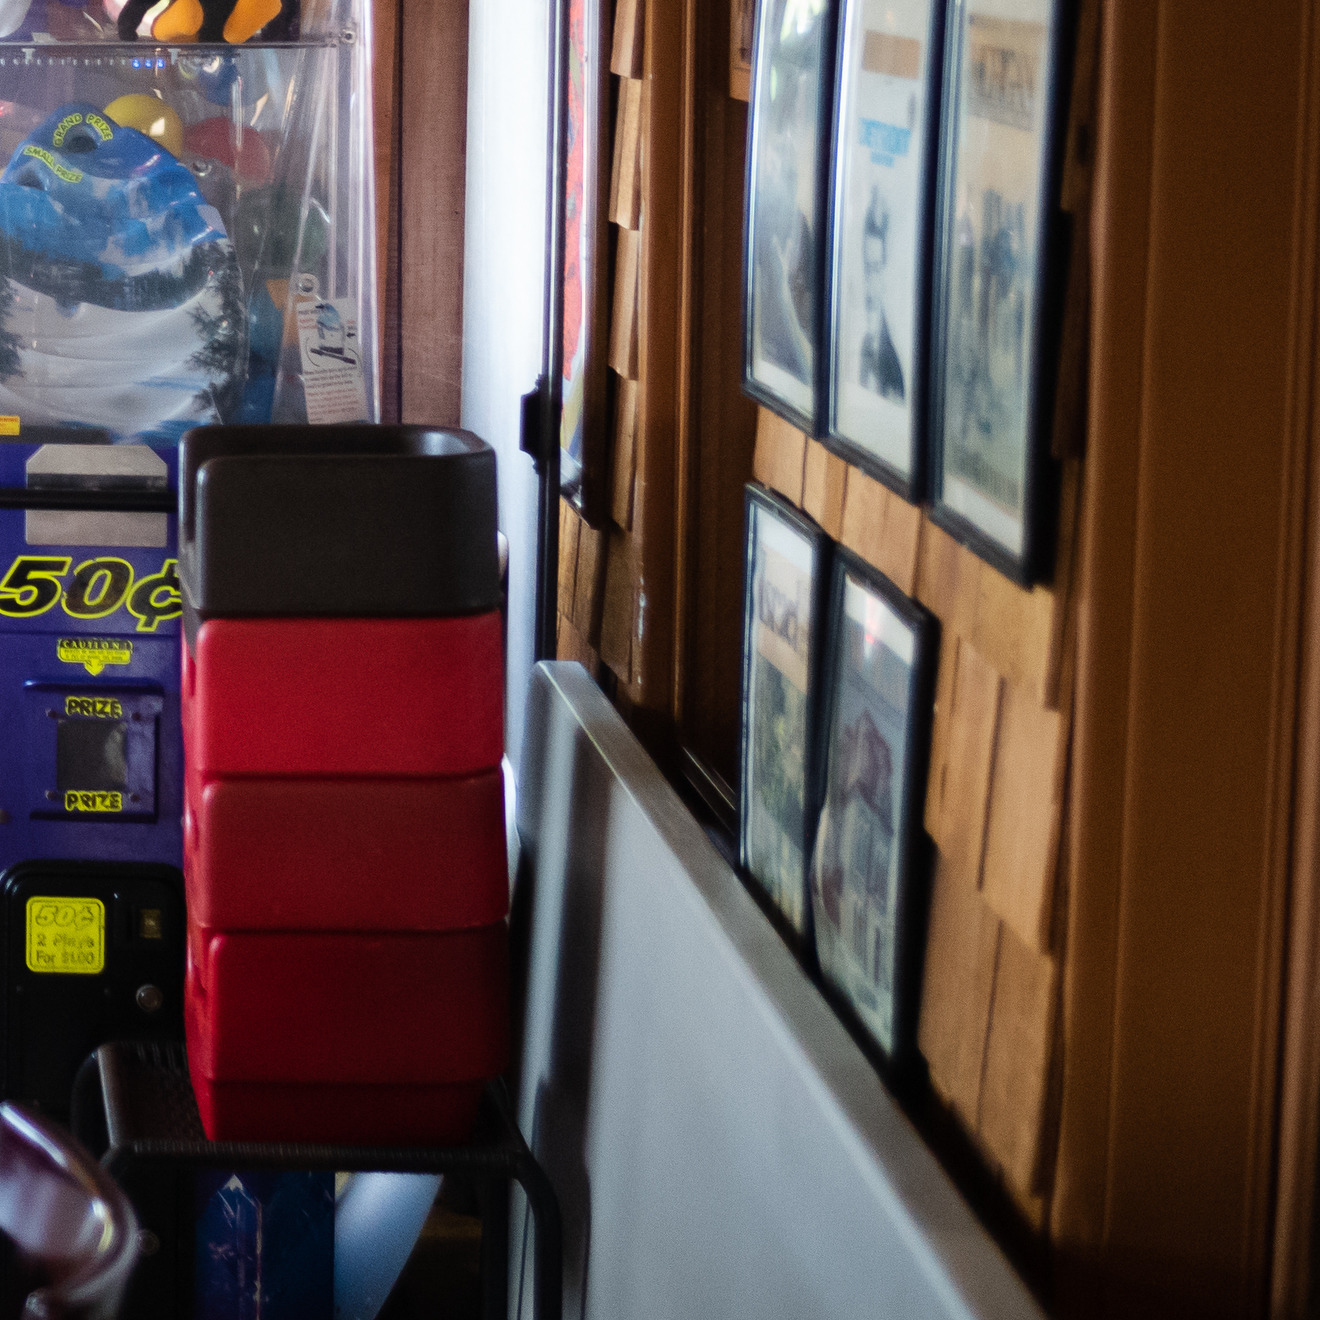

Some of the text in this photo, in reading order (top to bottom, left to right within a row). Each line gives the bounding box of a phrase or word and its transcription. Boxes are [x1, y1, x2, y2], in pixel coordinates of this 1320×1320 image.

[53, 113, 113, 147] GRAND PRIZE
[24, 146, 82, 182] SMALL PRIZE
[66, 697, 122, 718] PRIZE
[65, 790, 122, 812] PRIZE
[37, 933, 47, 947] 2
[36, 950, 57, 964] For
